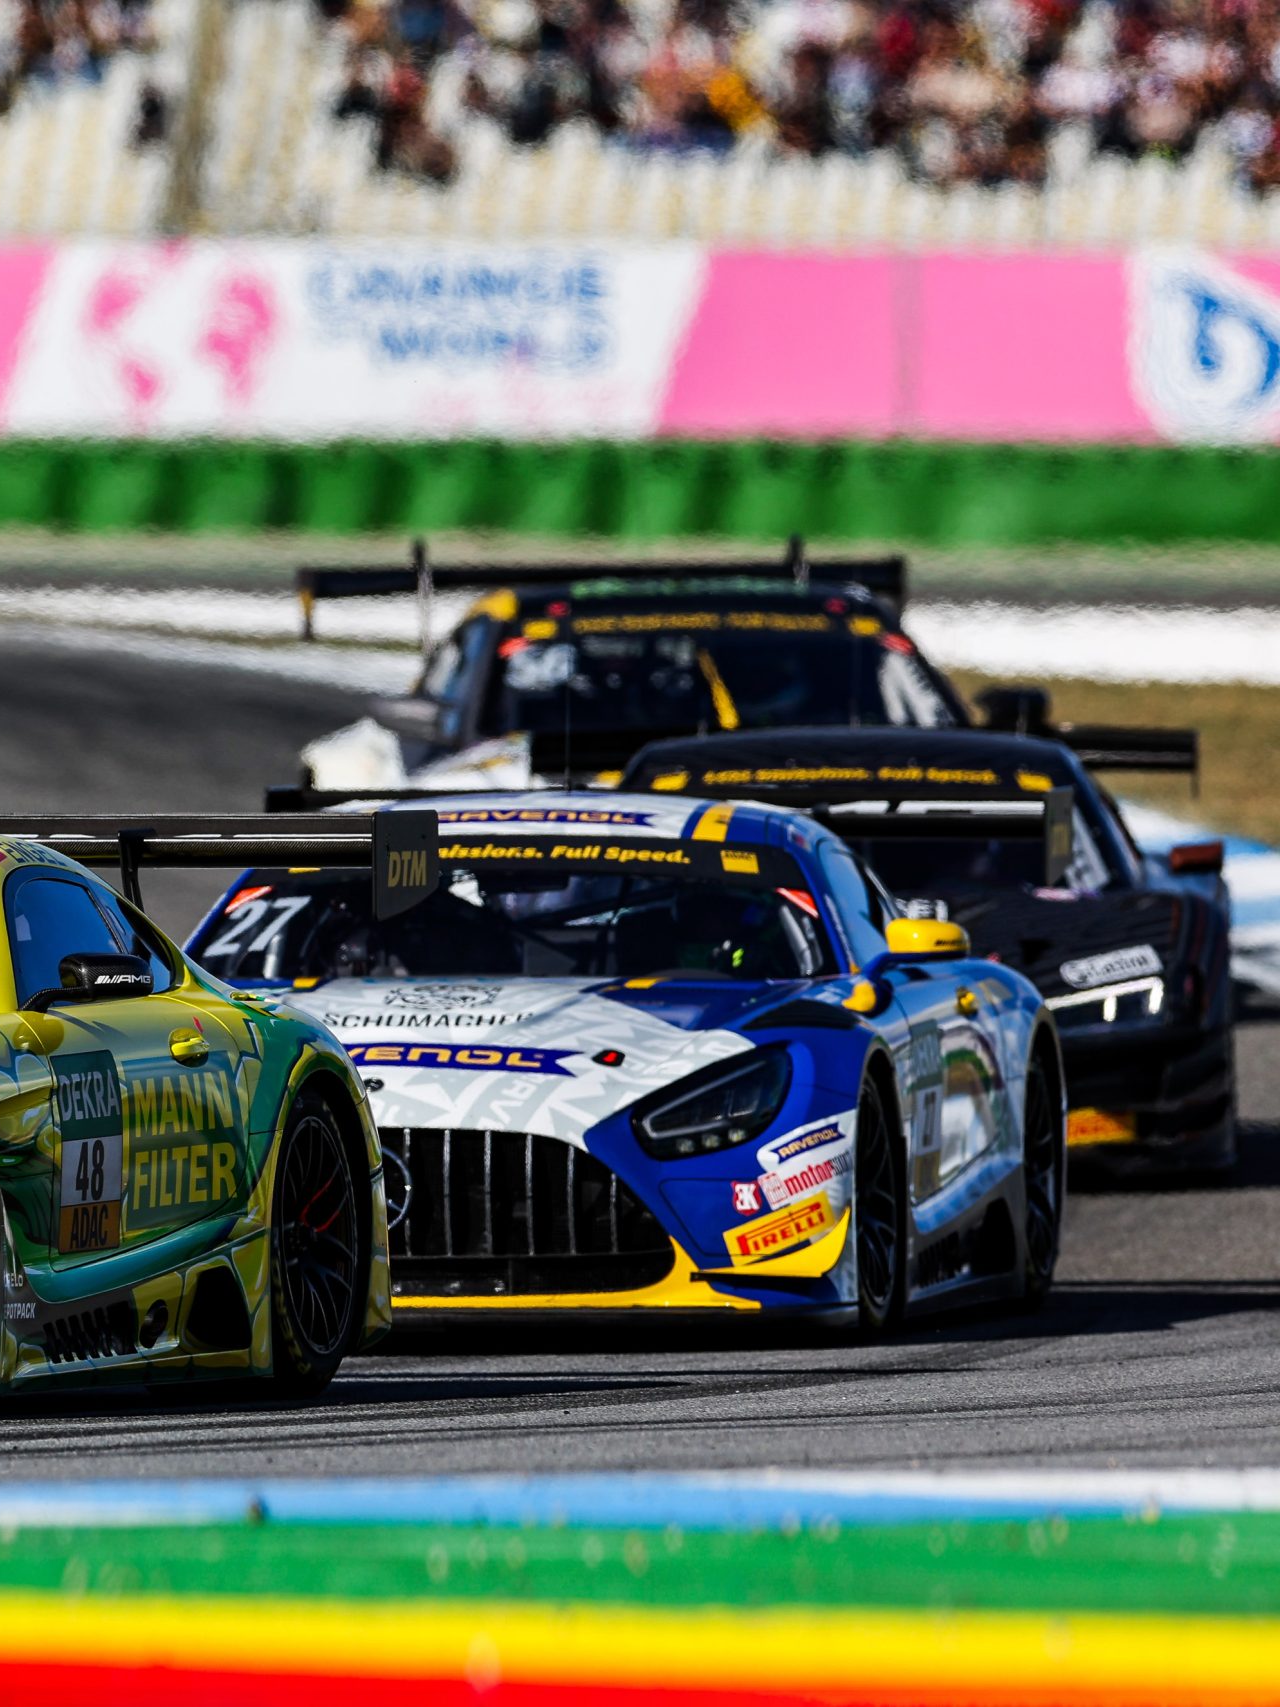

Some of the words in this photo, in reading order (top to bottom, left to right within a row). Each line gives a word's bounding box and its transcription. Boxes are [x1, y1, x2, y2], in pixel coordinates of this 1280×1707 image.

[387, 849, 427, 888] DTM
[550, 845, 600, 859] Full
[604, 846, 691, 864] Speed.
[203, 896, 312, 957] 27
[58, 1068, 120, 1121] DEKRA
[132, 1070, 234, 1138] MANN
[75, 1140, 105, 1201] 48
[133, 1142, 238, 1210] FILTER
[70, 1204, 109, 1250] ADAC
[736, 1201, 826, 1256] PIRELLI
